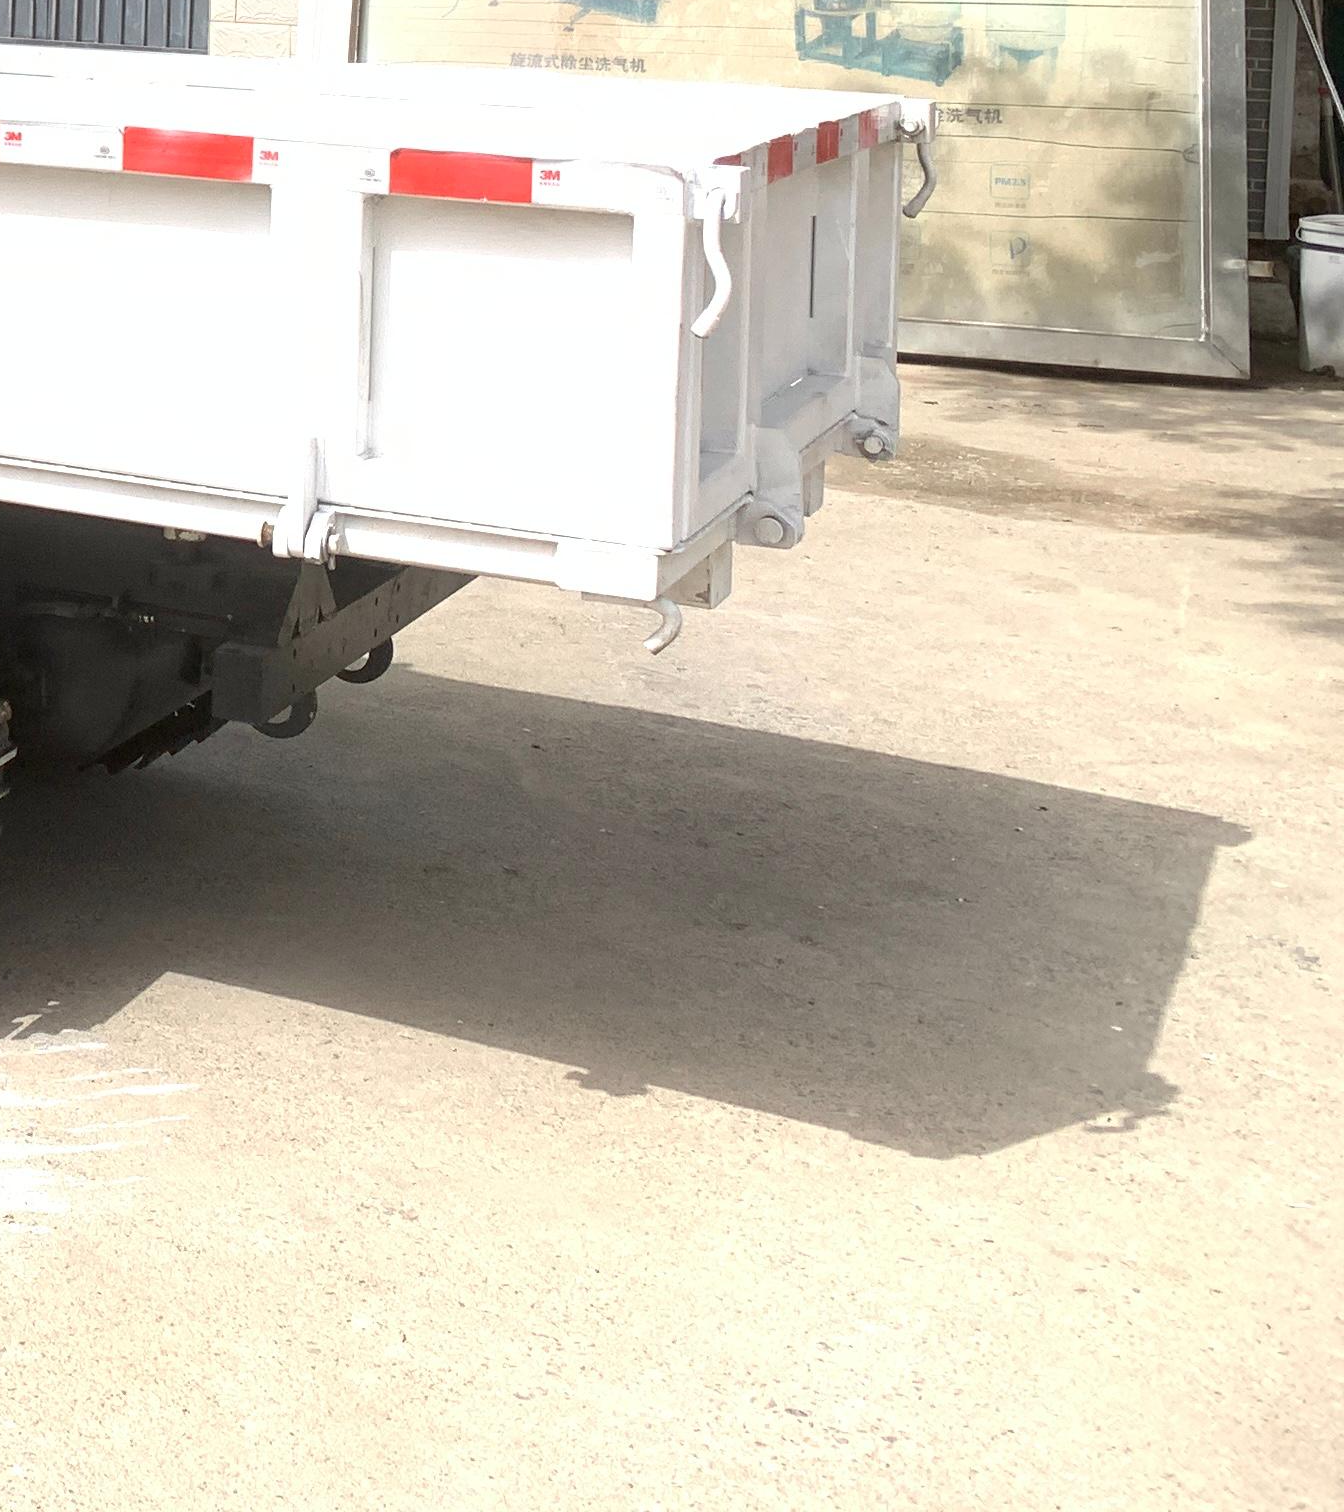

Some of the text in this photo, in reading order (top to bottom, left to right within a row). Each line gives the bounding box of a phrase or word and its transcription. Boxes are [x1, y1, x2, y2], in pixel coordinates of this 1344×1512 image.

[509, 52, 647, 74] 旋流式除尘洗气机
[4, 131, 22, 142] 3M
[260, 150, 279, 161] 3M
[539, 170, 560, 181] 3M
[994, 176, 1026, 186] PM2.5
